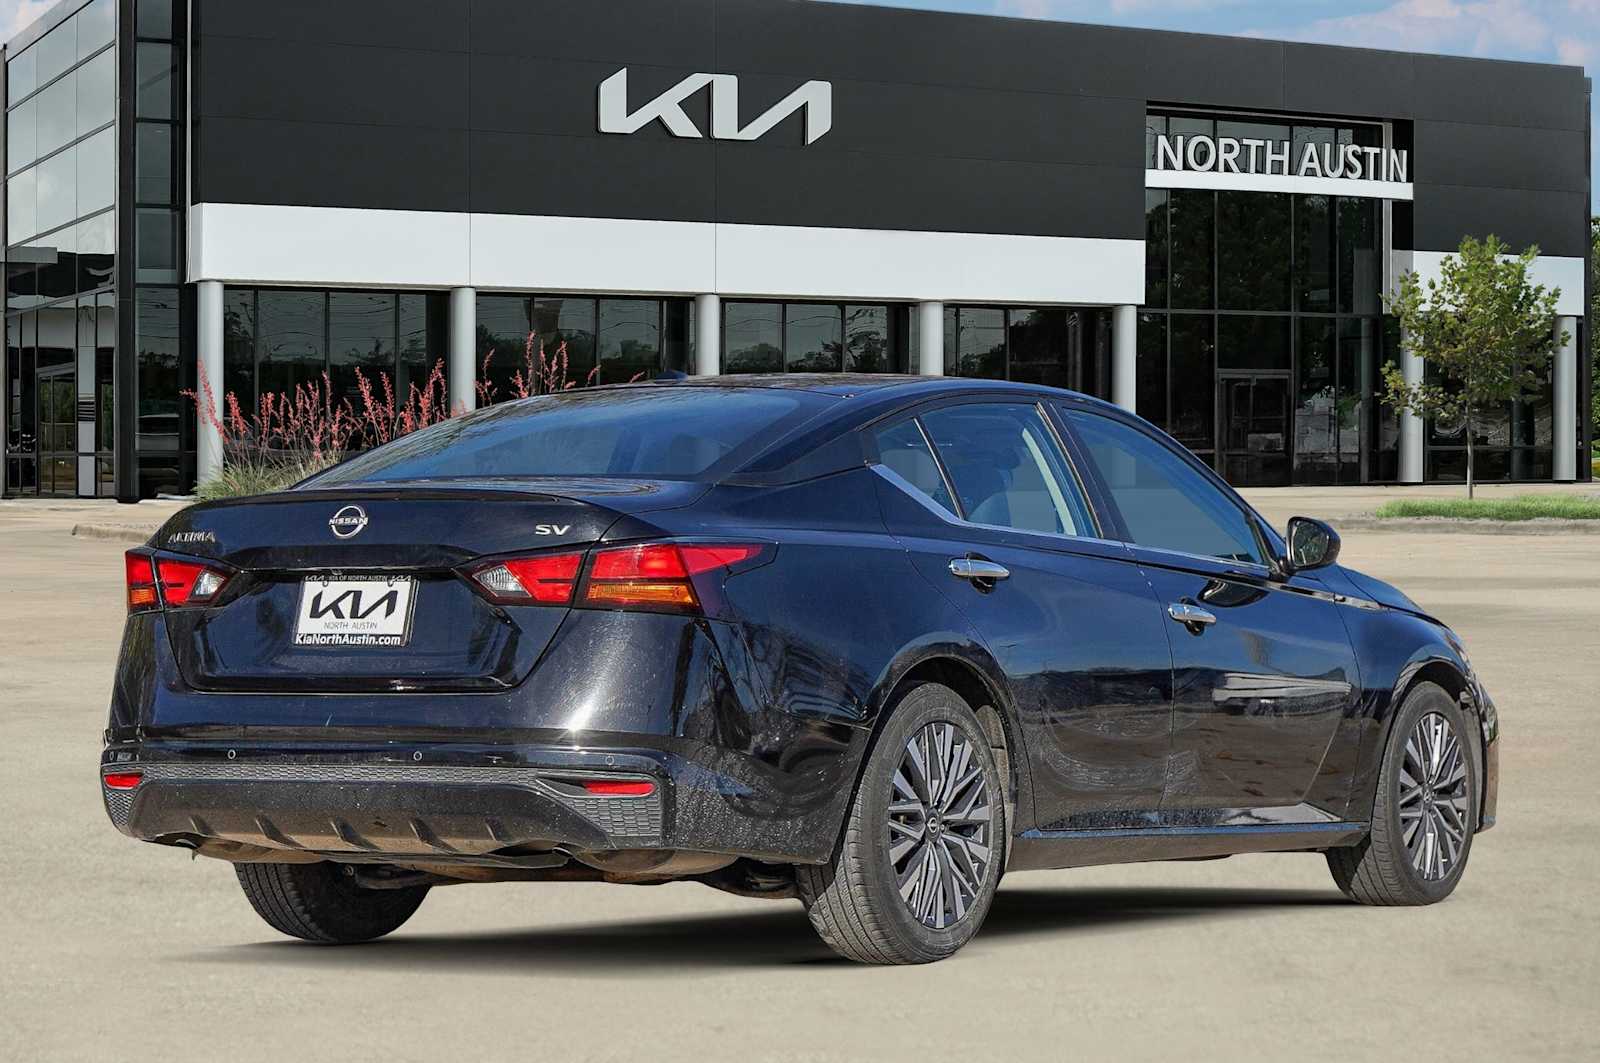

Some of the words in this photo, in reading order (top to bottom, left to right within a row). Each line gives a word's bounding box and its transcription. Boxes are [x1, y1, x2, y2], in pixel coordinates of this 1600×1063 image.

[598, 67, 832, 145] KIA
[1156, 134, 1291, 175] NORTH
[1299, 142, 1408, 182] AUSTIN
[329, 517, 369, 525] NISSAN
[535, 524, 570, 535] SV
[167, 531, 216, 543] ALTIMA
[309, 590, 398, 619] KIA
[324, 622, 348, 630] NORTH
[352, 622, 378, 630] AUSTIN
[295, 633, 401, 645] KiaNorthAustin.com
